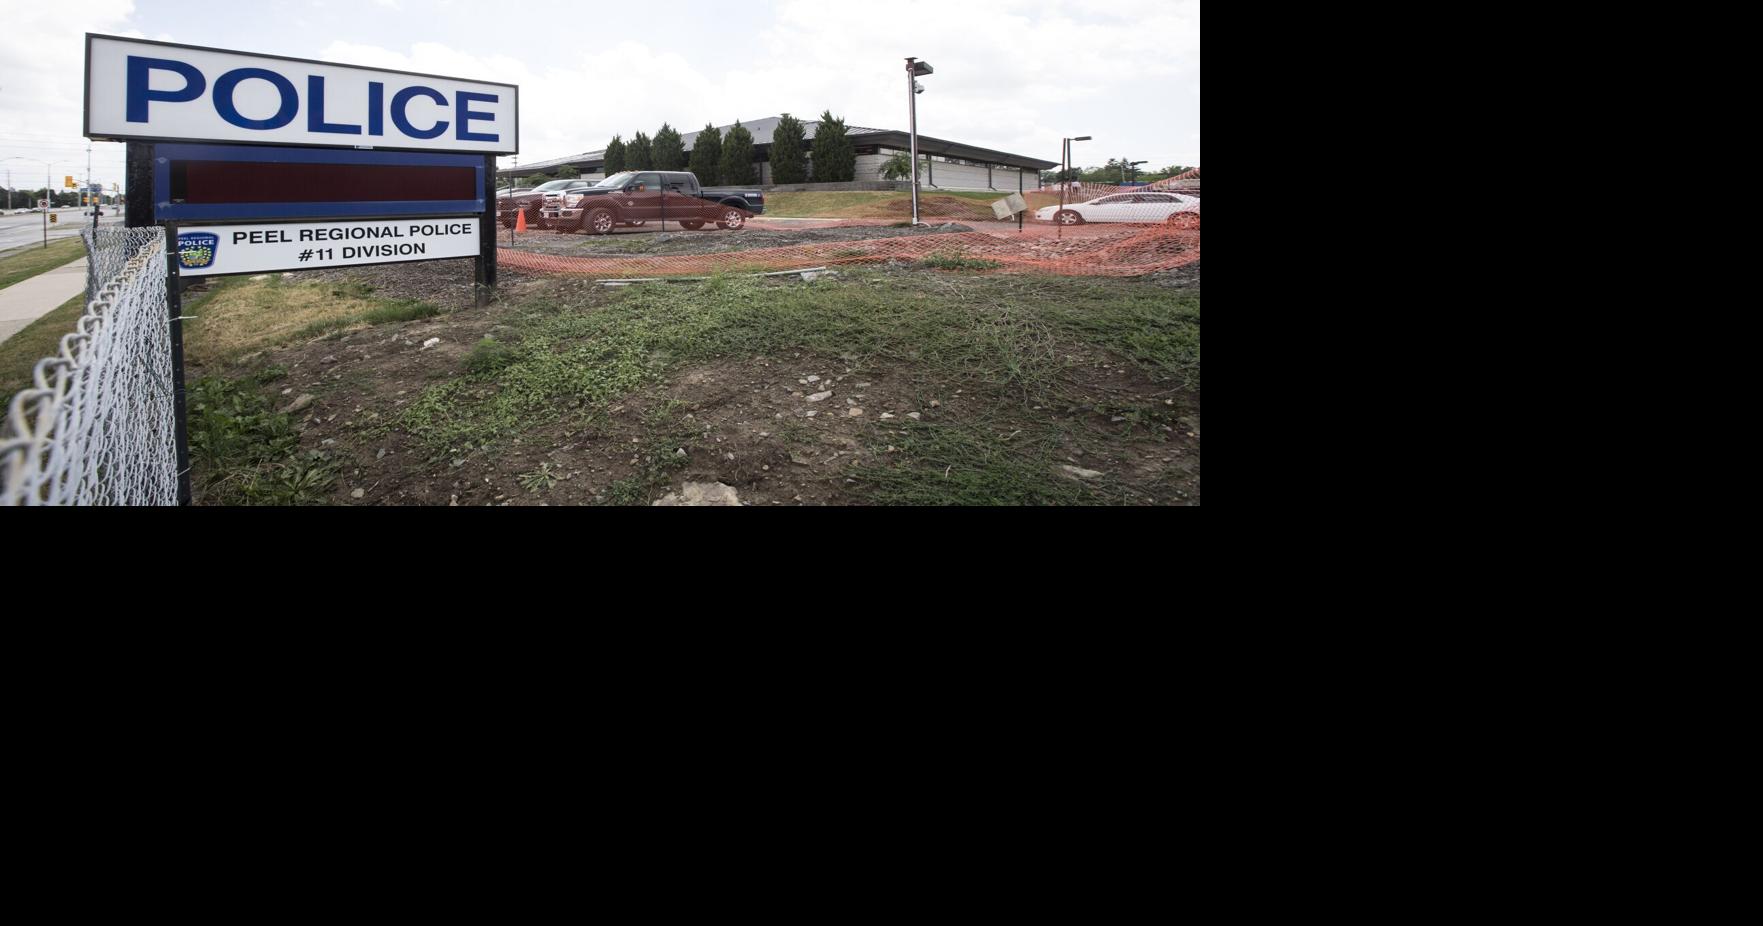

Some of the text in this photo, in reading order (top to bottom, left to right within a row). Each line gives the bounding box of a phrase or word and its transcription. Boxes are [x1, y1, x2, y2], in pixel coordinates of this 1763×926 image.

[125, 54, 500, 143] POLICE
[232, 223, 472, 245] PEEL REGIONAL POLICE
[298, 242, 426, 262] #11 DIVISION
